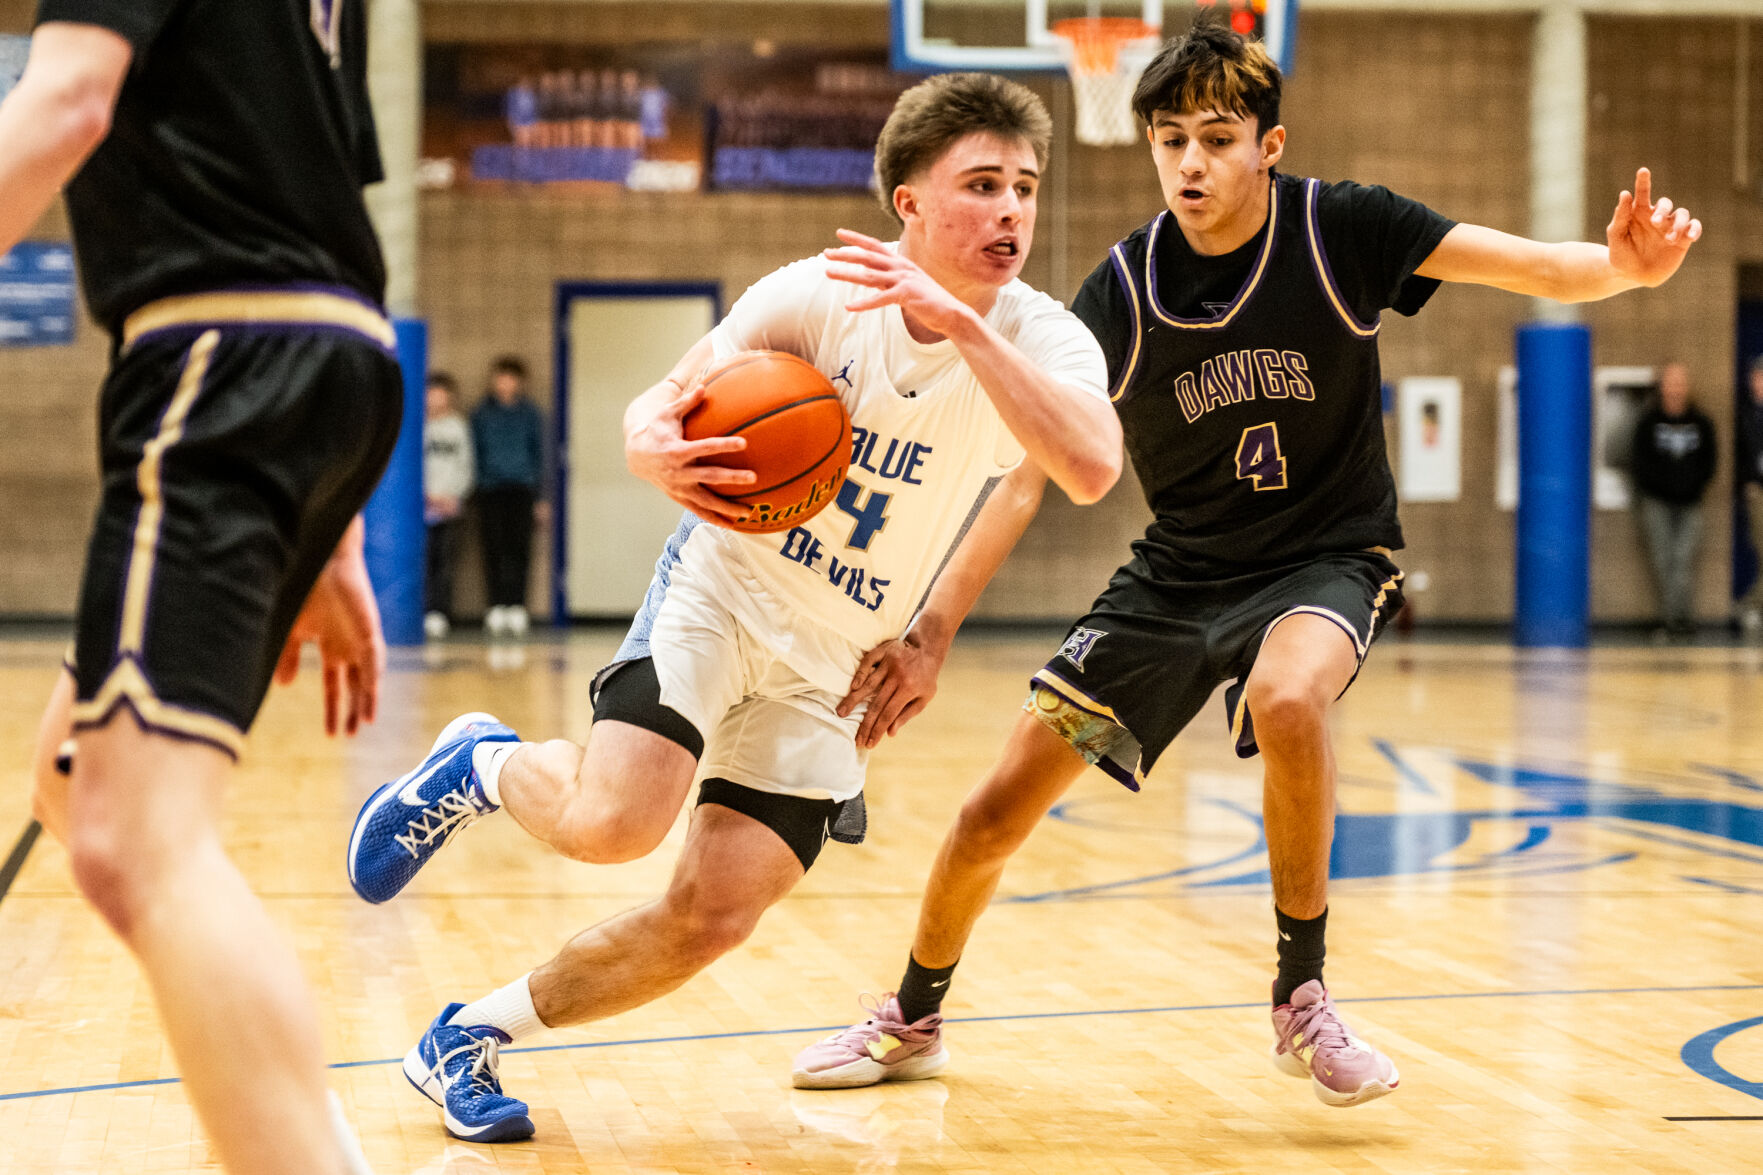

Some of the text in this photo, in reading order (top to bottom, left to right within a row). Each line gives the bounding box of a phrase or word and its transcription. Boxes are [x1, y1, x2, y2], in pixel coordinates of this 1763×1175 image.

[1174, 349, 1315, 424] DAWGS
[1234, 421, 1288, 492] 4
[737, 466, 842, 523] Baden
[833, 476, 895, 553] 4
[779, 526, 891, 611] DEVILS
